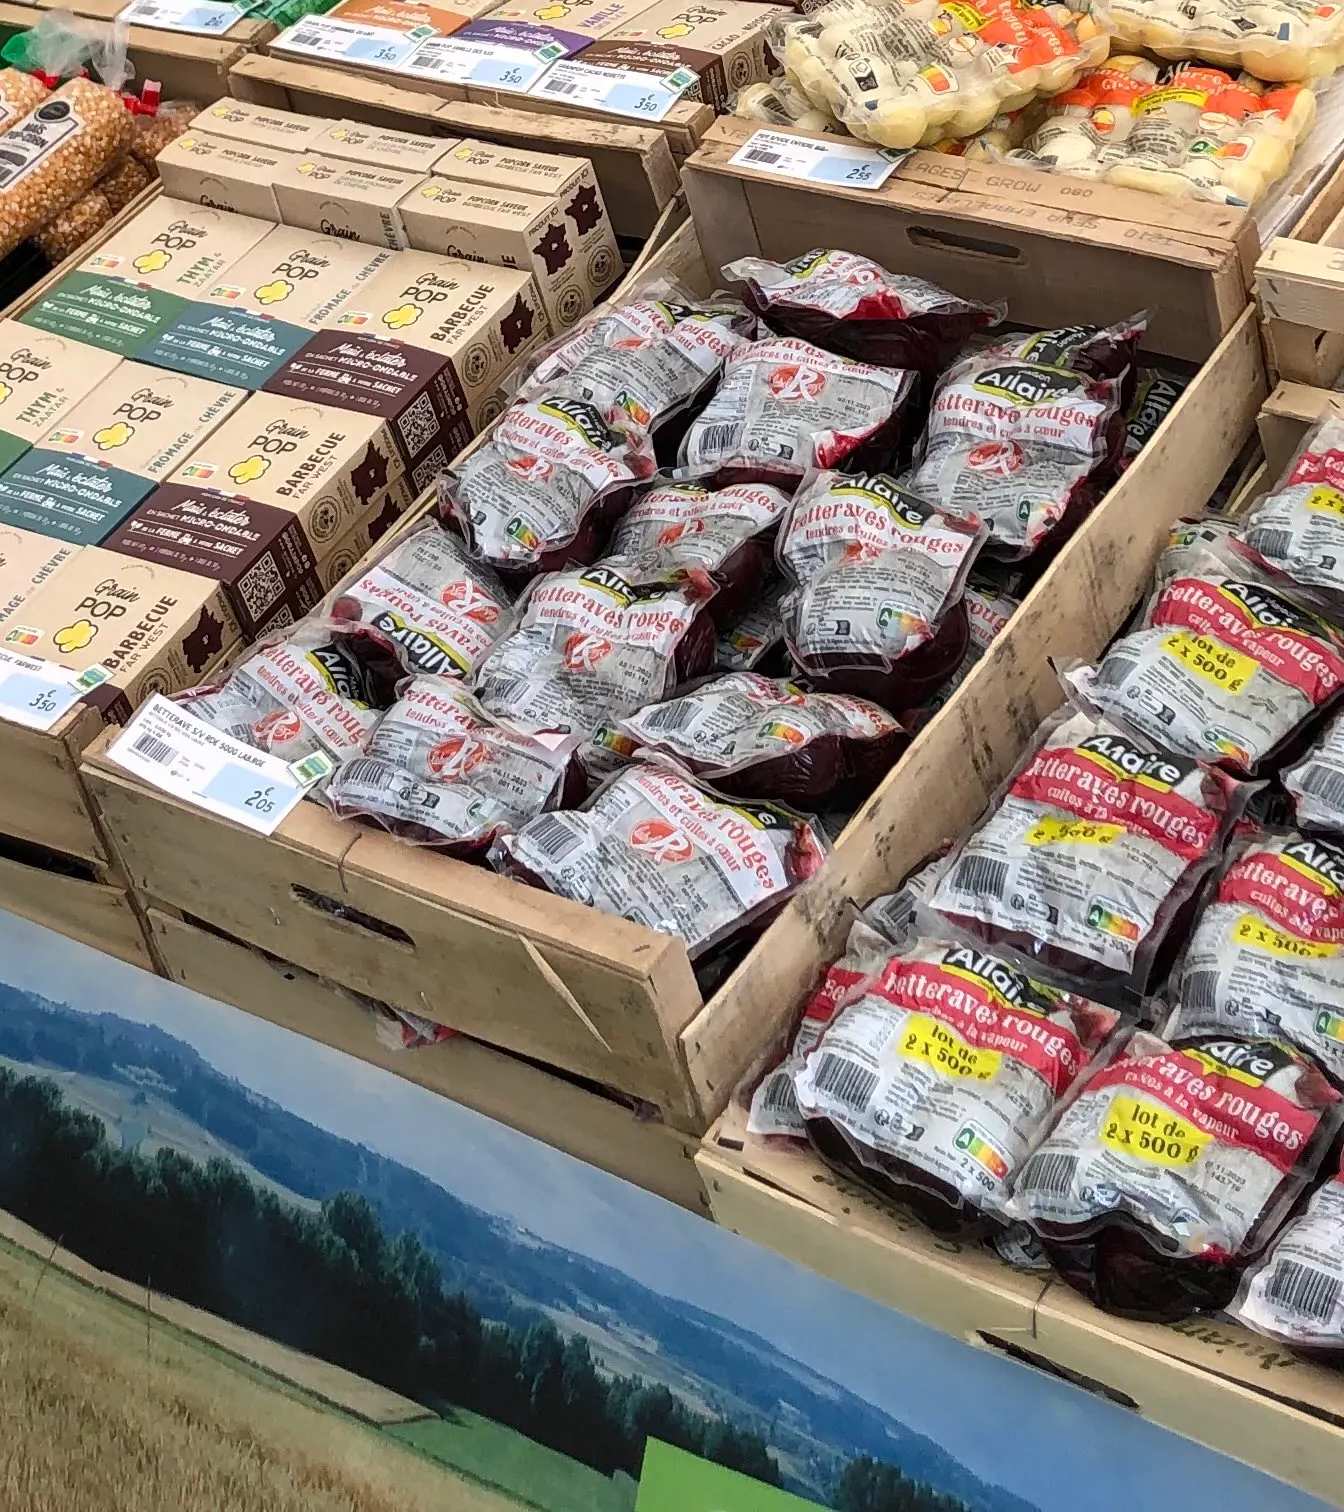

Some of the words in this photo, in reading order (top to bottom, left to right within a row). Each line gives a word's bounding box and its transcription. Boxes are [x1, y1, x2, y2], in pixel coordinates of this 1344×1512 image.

[95, 578, 142, 604] Grain
[74, 597, 128, 620] POP
[104, 594, 178, 671] BARBECUE
